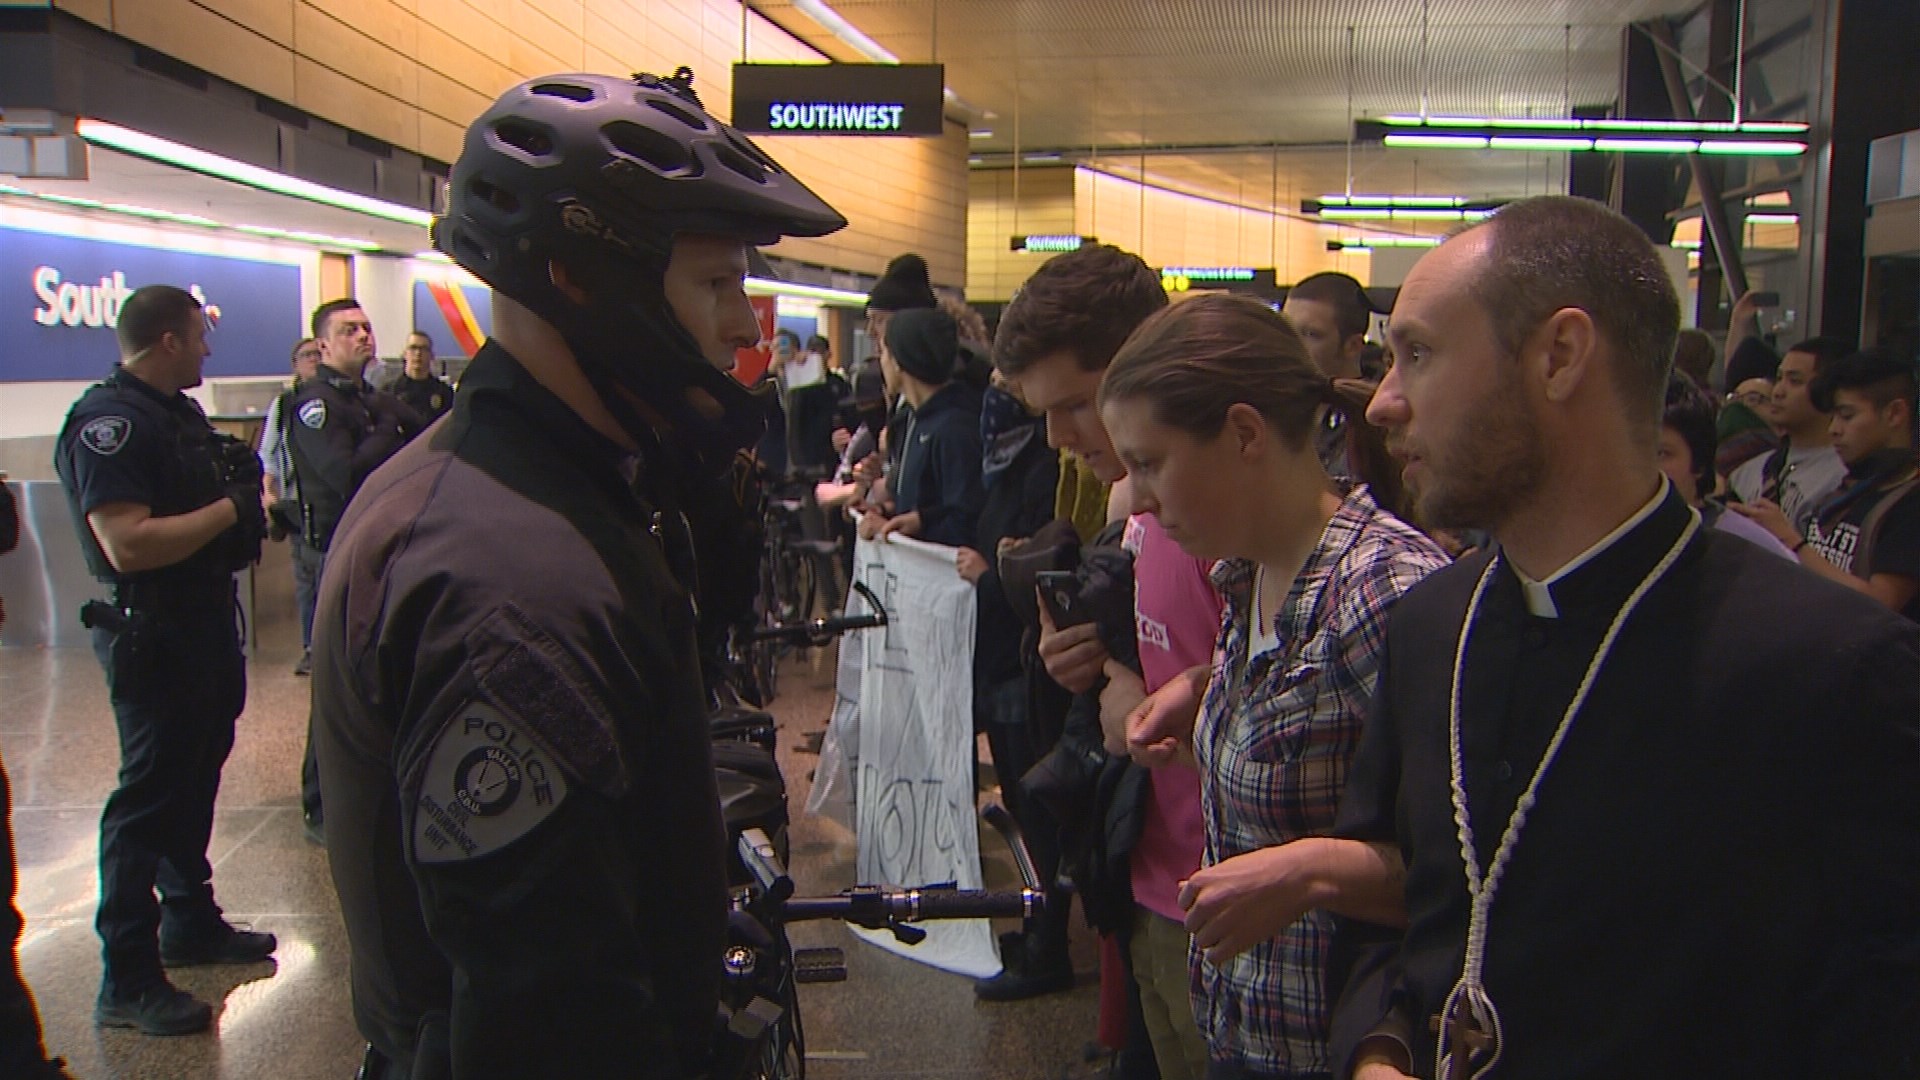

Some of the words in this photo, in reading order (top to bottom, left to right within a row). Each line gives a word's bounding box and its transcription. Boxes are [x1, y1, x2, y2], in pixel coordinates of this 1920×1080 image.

[769, 103, 904, 130] SOUTHWEST
[464, 716, 553, 807] POLICE
[424, 823, 450, 850] UNIT
